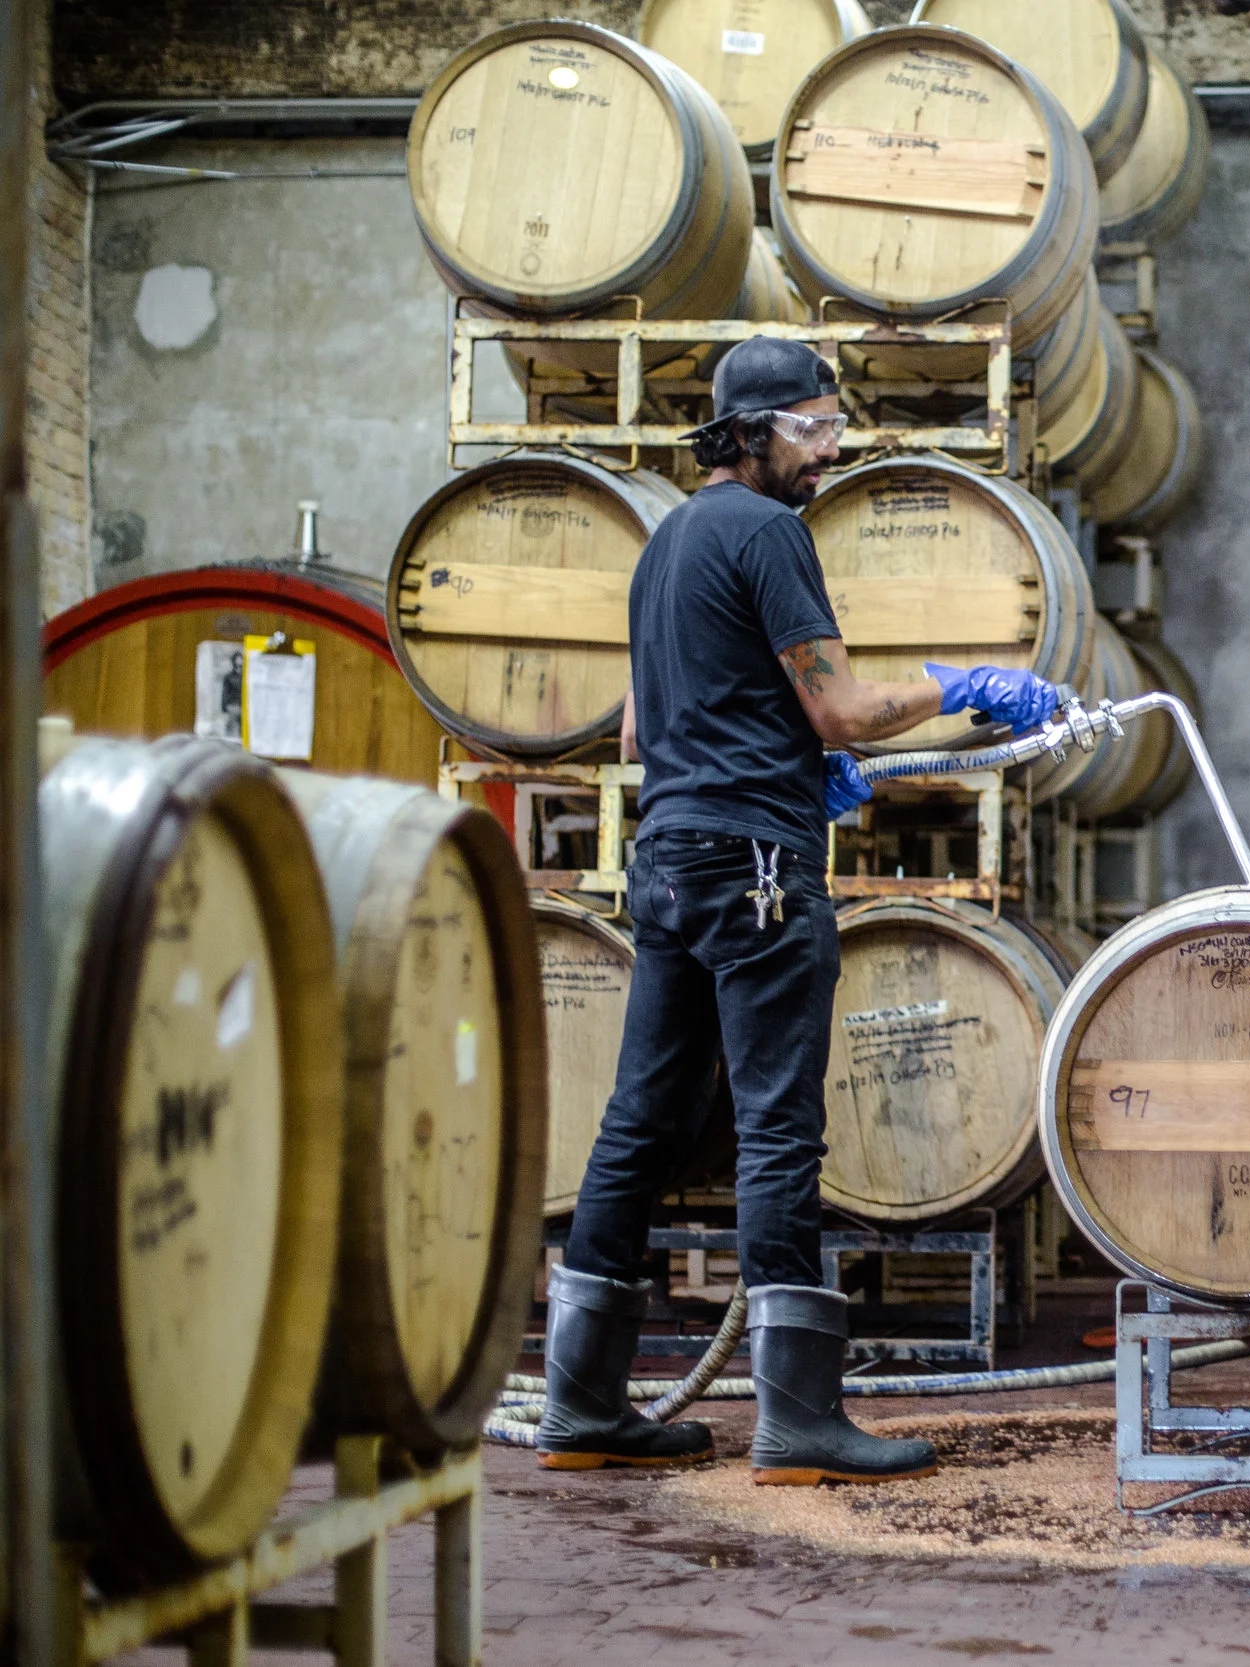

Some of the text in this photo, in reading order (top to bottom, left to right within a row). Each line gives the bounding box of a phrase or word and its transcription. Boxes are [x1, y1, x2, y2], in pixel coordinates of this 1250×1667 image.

[450, 126, 476, 145] 109
[450, 575, 474, 600] 90
[1108, 1084, 1152, 1120] 97
